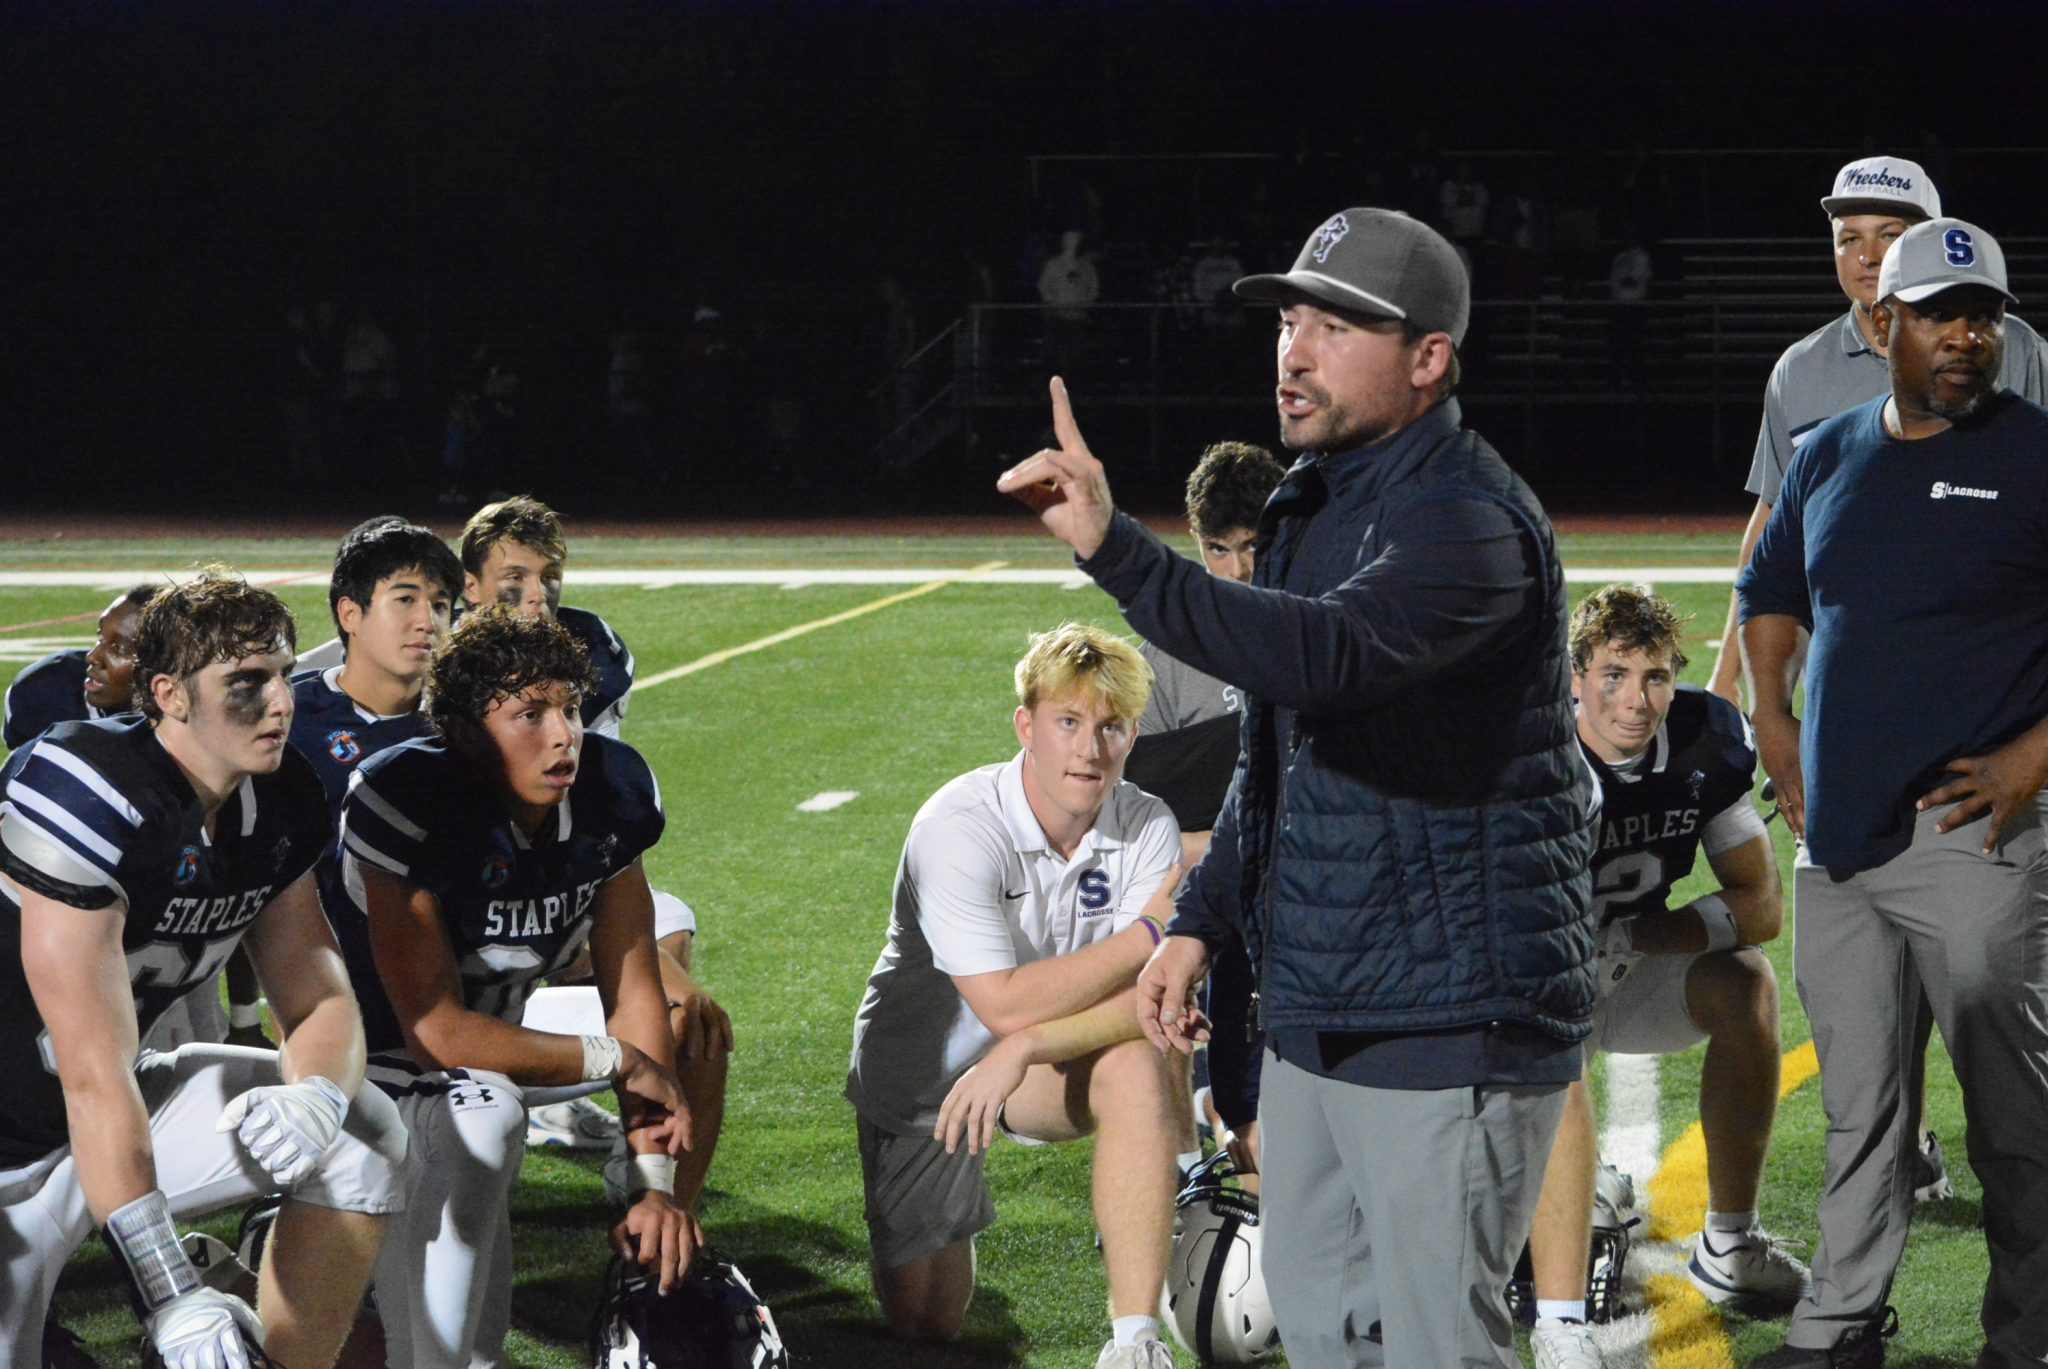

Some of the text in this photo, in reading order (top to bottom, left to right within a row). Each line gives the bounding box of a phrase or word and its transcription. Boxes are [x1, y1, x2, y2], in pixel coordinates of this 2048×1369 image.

[1843, 167, 1913, 191] Wreckers
[1943, 229, 1975, 267] S
[1602, 809, 1700, 850] APLES
[154, 885, 273, 934] STAPLES
[484, 877, 604, 938] STAPLES
[1078, 869, 1111, 910] S
[1077, 908, 1114, 918] LACROSSE
